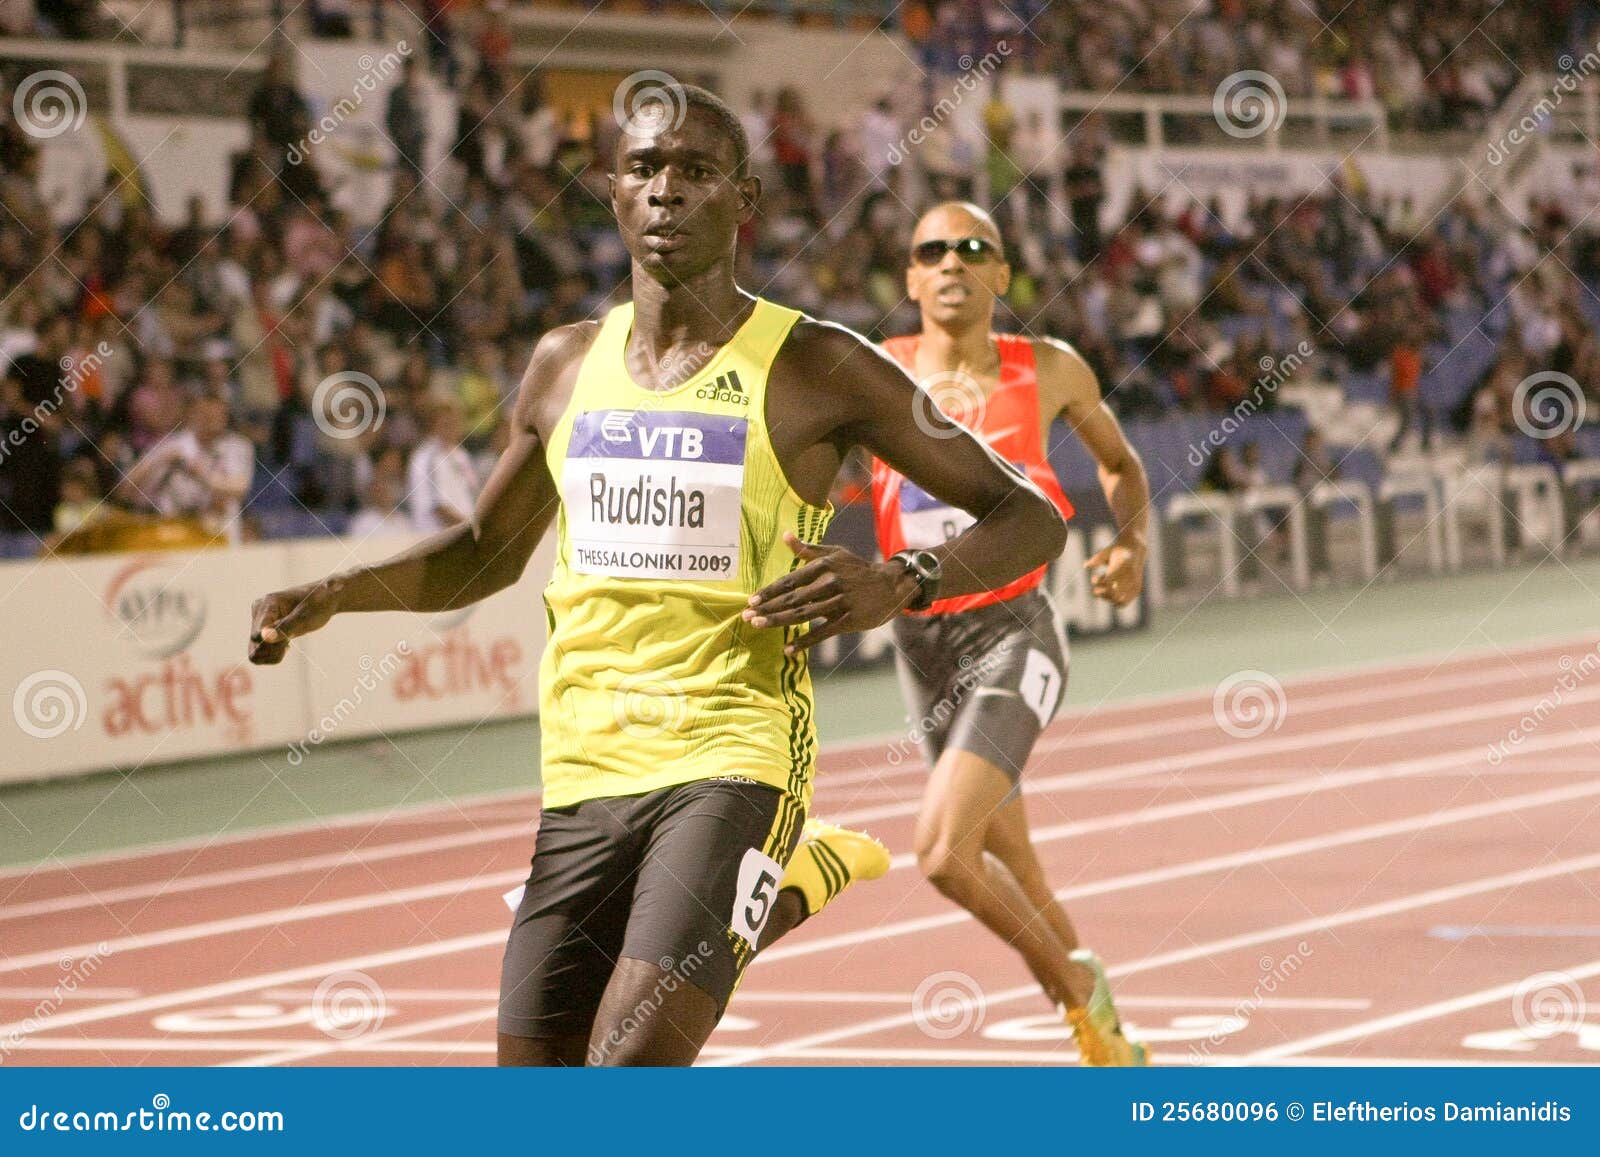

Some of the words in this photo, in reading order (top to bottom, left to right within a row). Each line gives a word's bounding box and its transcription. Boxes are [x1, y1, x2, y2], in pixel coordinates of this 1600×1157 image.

[696, 388, 750, 406] adidas
[637, 426, 704, 459] VTB
[590, 472, 705, 529] Rudisha
[577, 548, 683, 571] THESSALONIKI
[687, 554, 732, 573] 2009
[391, 624, 524, 703] active
[102, 651, 254, 740] active
[744, 869, 777, 932] 5
